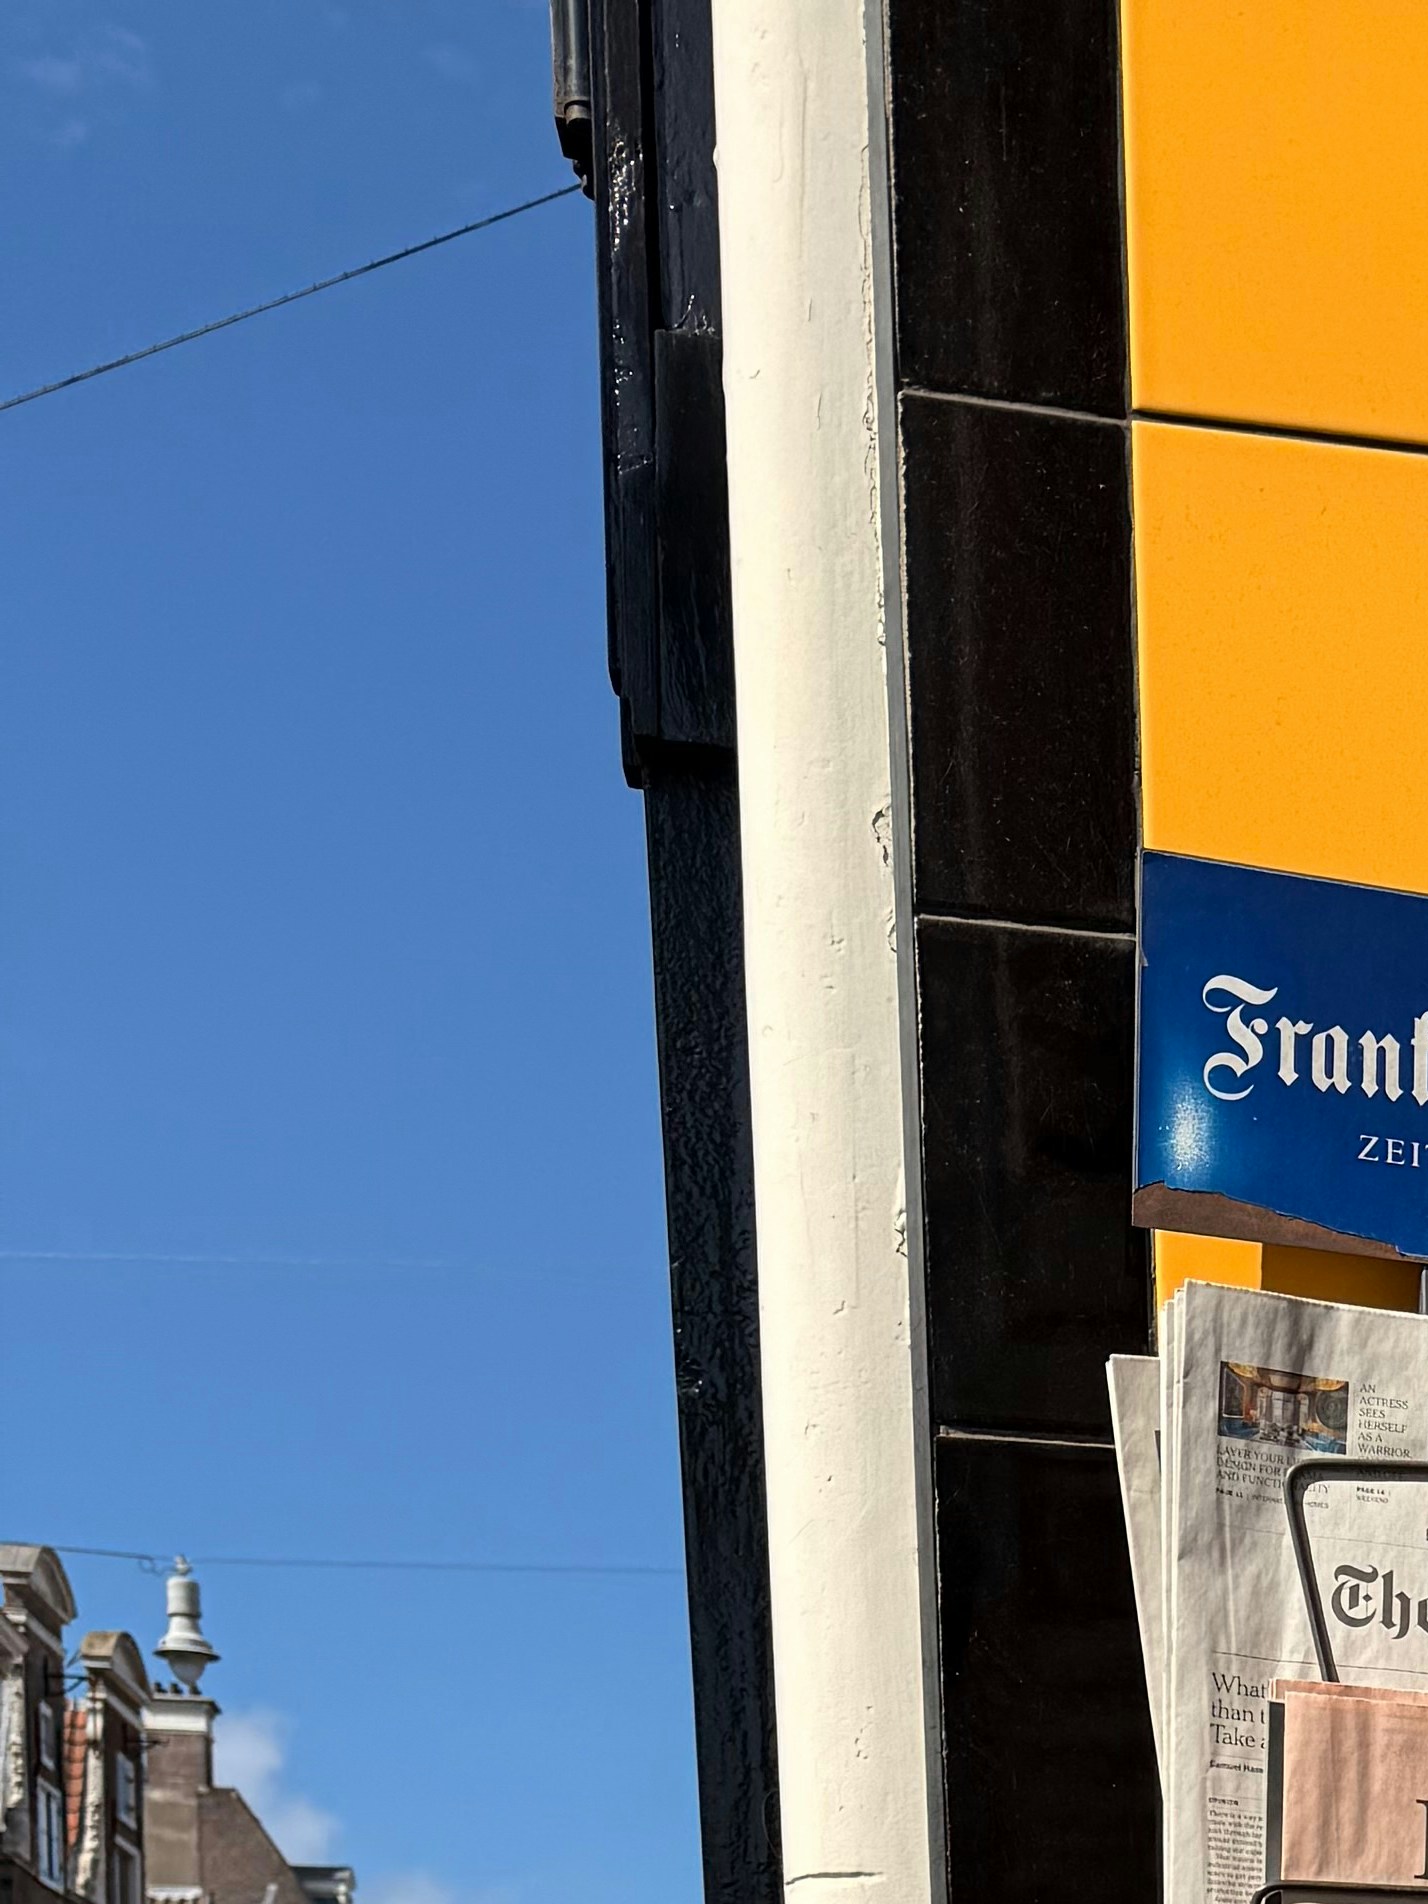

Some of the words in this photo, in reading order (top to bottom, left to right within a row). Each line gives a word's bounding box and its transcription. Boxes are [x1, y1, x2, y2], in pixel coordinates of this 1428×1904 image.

[1212, 1672, 1267, 1699] What
[1212, 1704, 1254, 1722] than
[1210, 1722, 1254, 1747] Take
